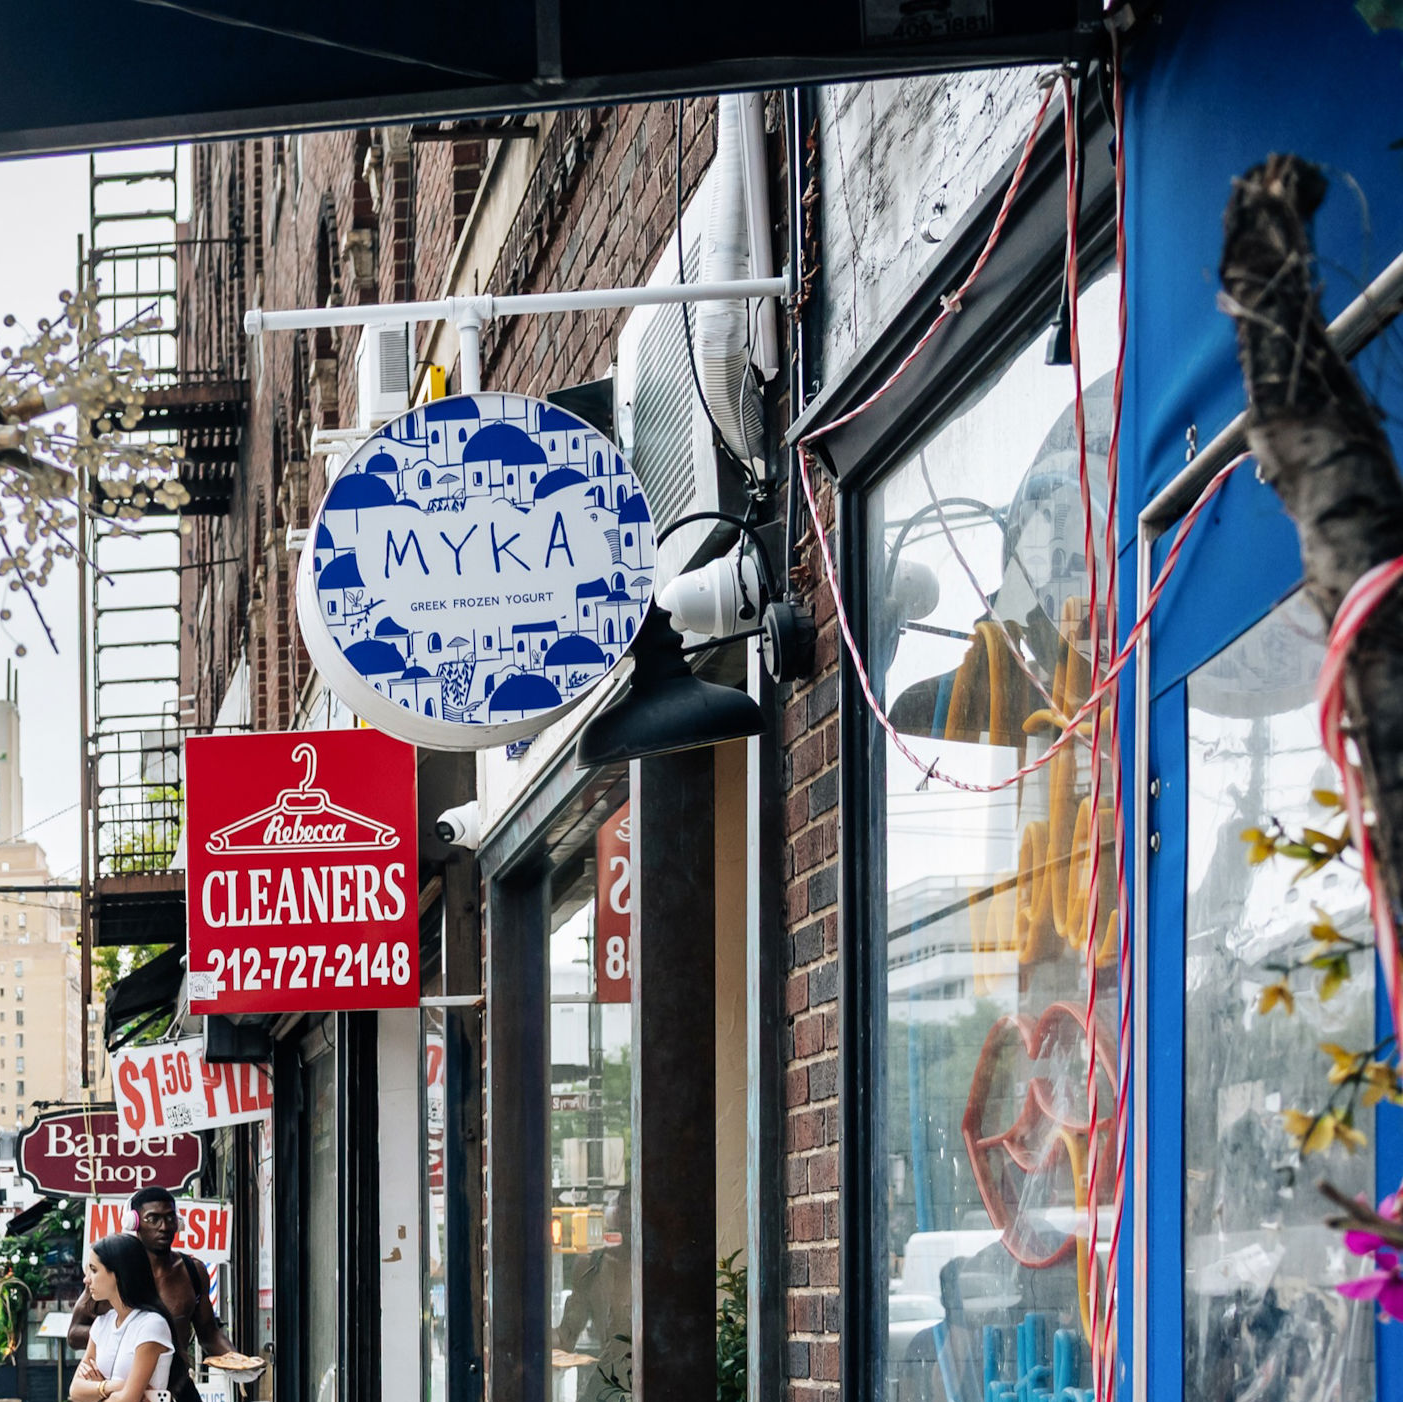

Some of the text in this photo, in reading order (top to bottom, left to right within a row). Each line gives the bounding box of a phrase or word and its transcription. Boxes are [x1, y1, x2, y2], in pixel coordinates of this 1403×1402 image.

[385, 511, 574, 579] MYKA
[410, 592, 554, 612] GREEK FROZEN YOGURT
[262, 814, 346, 845] Rebecca
[202, 862, 406, 928] CLEANERS
[207, 941, 411, 993] 212-727-2148
[118, 1050, 192, 1136] $1.50
[74, 1158, 157, 1189] Shop
